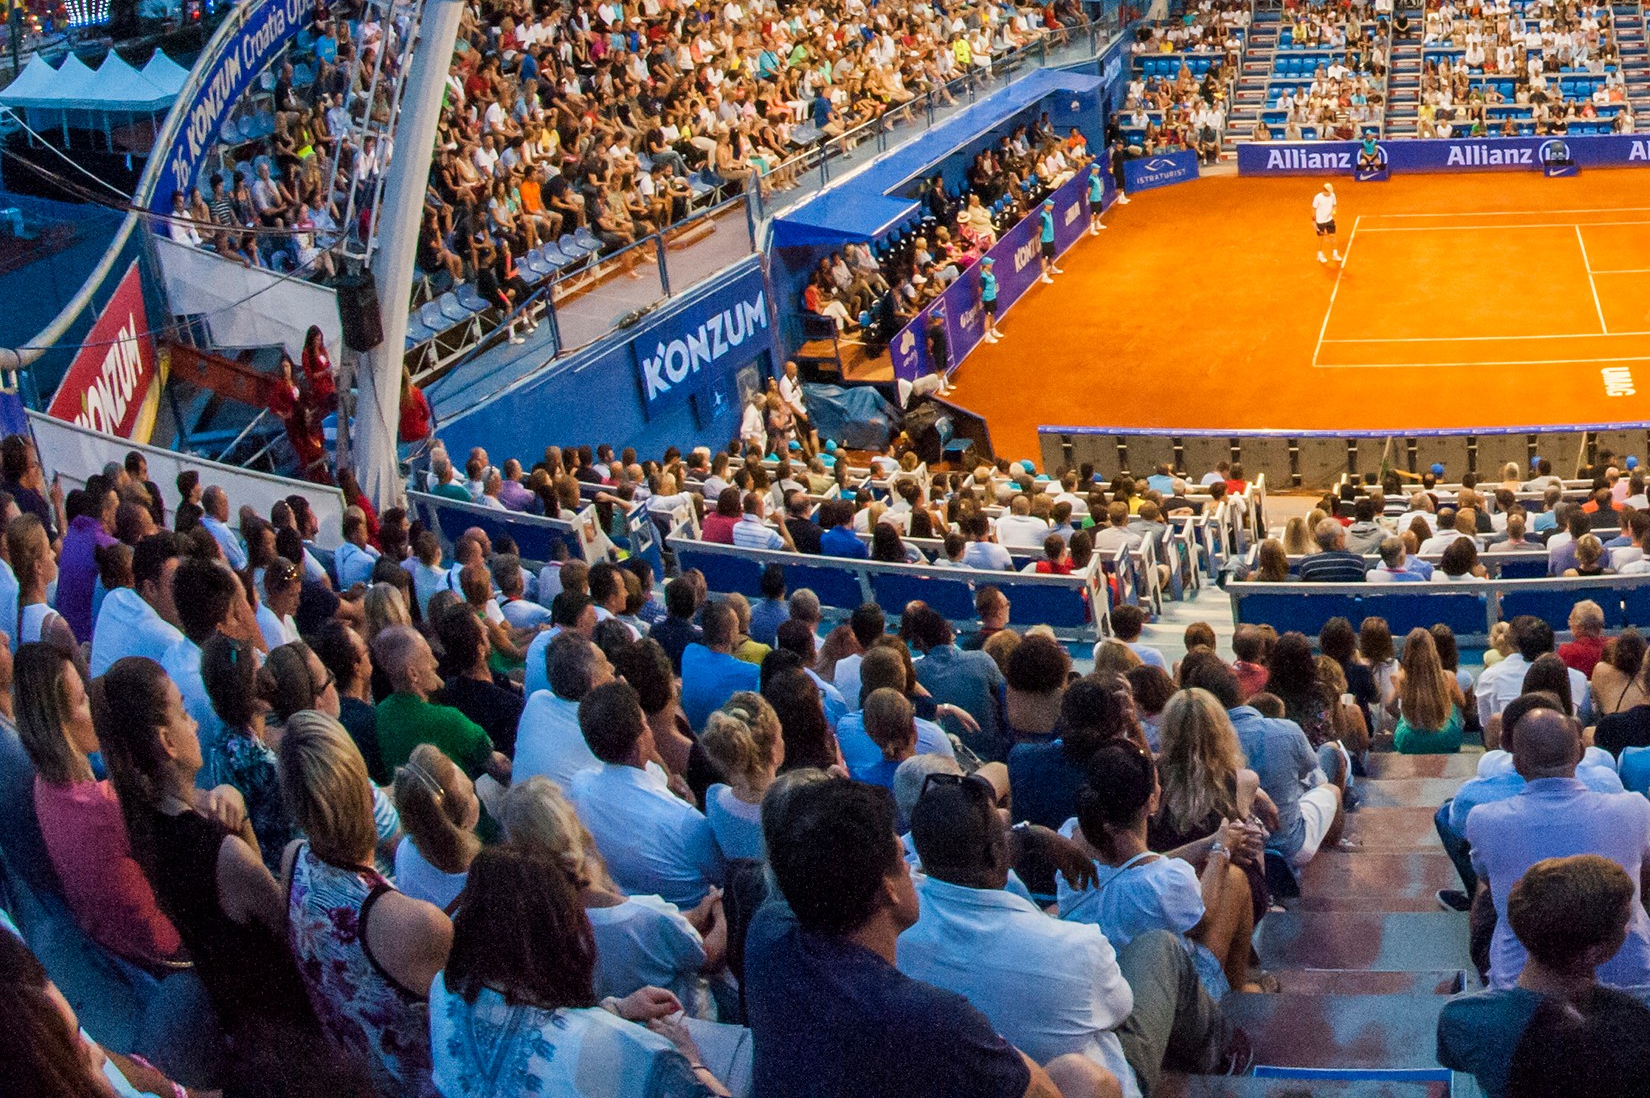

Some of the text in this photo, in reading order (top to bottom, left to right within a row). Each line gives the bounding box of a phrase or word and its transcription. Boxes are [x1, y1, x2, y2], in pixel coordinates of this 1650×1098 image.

[187, 45, 242, 165] KONZUM
[243, 3, 285, 71] Croatia
[1136, 168, 1186, 185] ISTRATURIST
[1267, 148, 1352, 170] Allianz
[1447, 144, 1533, 167] Allianz
[74, 312, 143, 436] ONZUM
[642, 290, 768, 401] KONZUM
